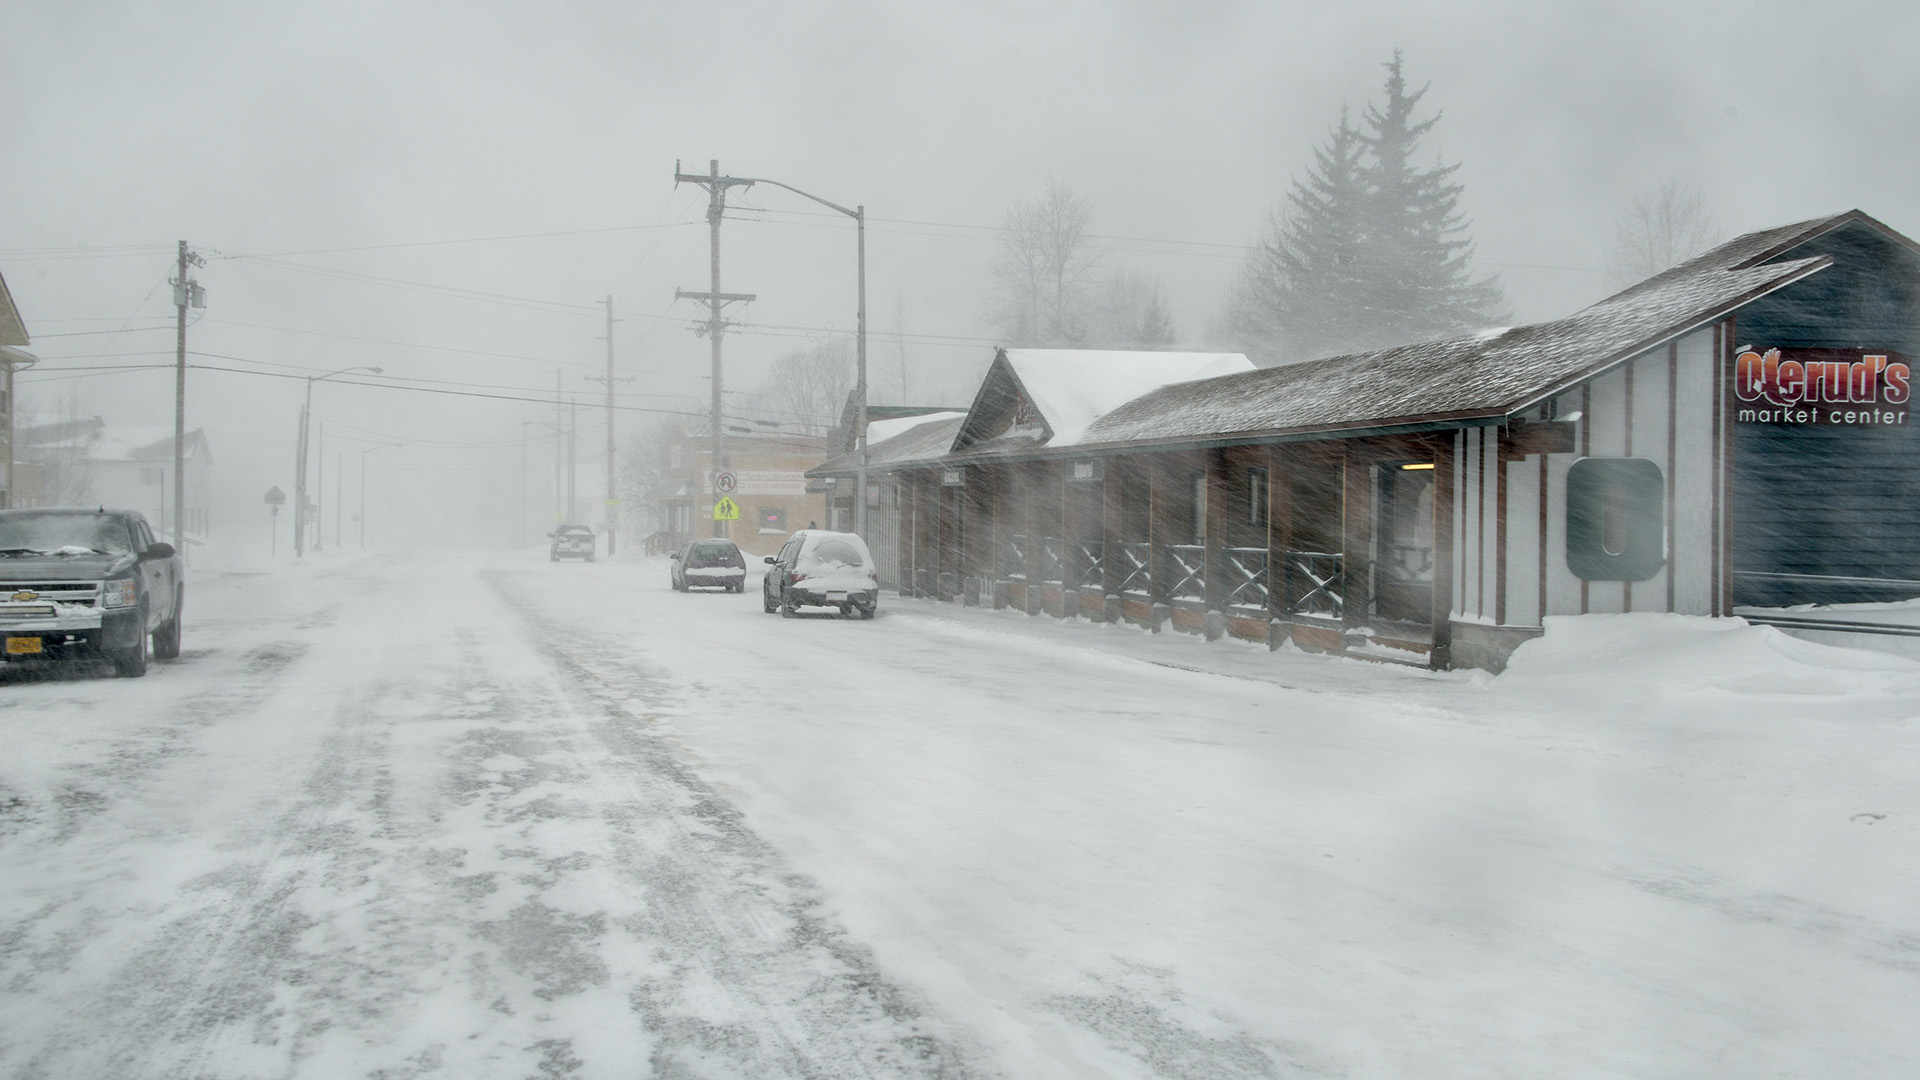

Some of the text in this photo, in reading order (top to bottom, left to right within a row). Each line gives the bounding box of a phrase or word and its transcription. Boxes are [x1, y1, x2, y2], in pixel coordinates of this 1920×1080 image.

[1735, 348, 1910, 406] Olerud's
[1739, 407, 1905, 424] market center
